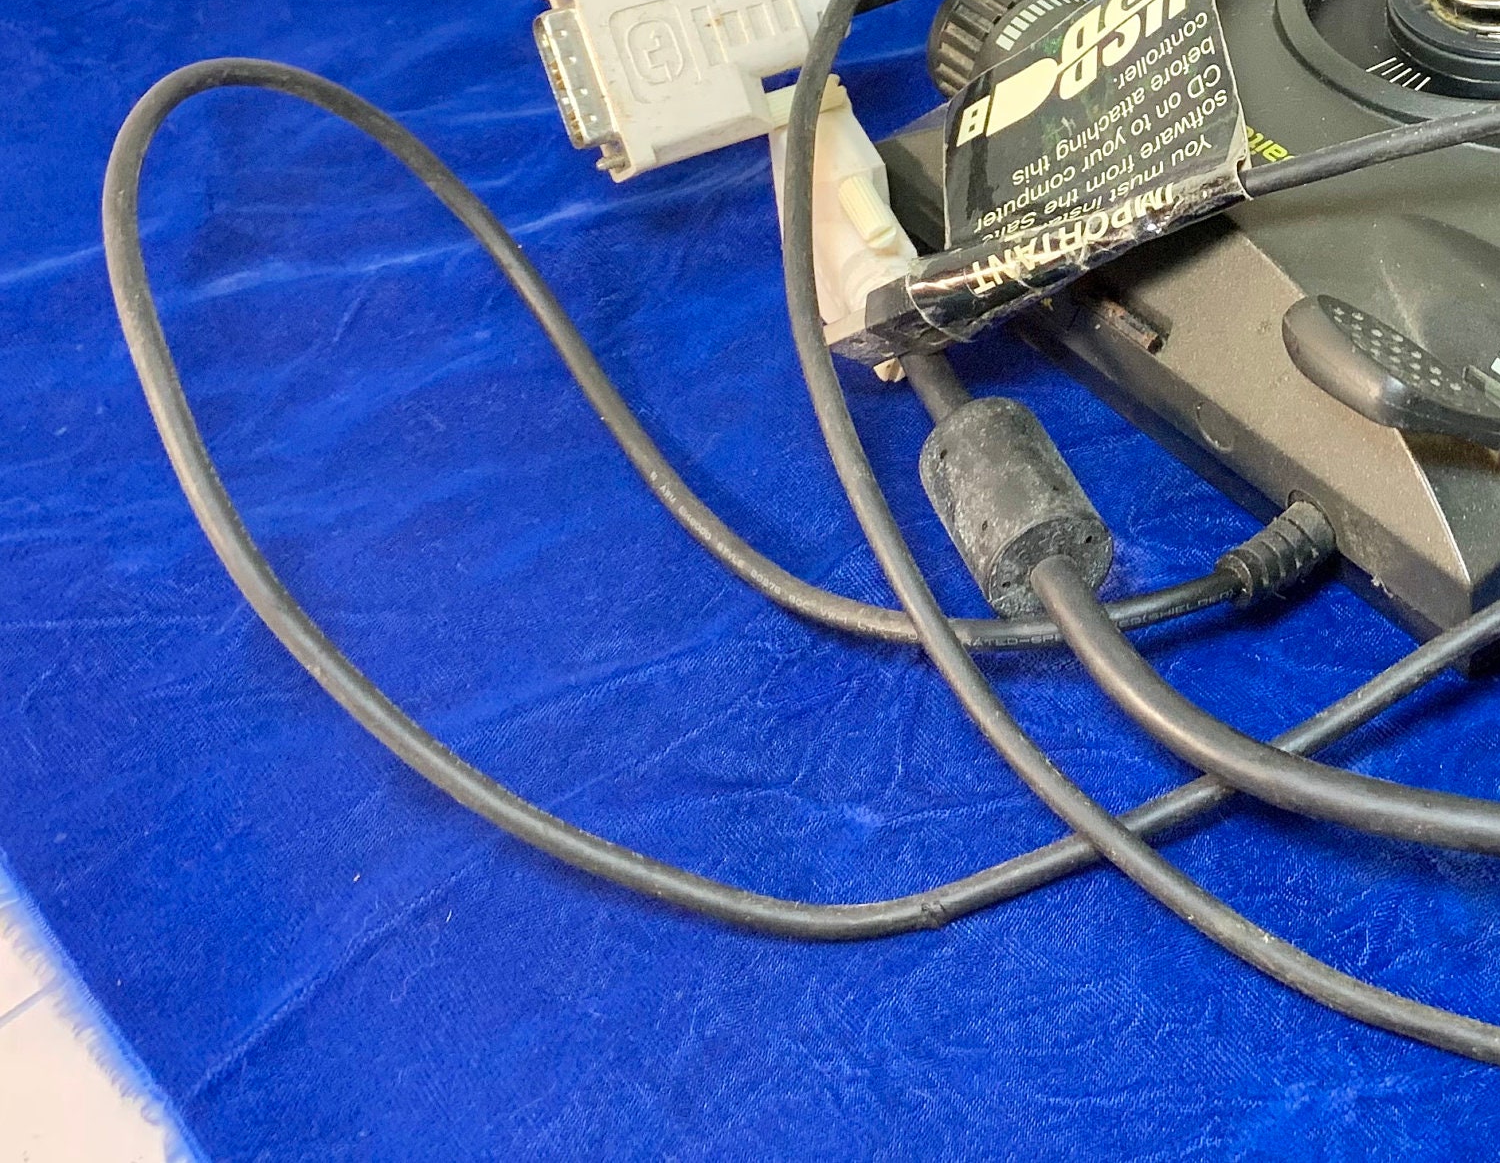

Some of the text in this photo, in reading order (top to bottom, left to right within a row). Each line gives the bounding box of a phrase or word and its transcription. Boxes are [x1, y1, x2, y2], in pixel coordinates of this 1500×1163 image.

[1113, 12, 1208, 90] controller.
[1011, 36, 1216, 186] before attaching this
[1140, 89, 1228, 159] software
[973, 64, 1221, 234] CD on to your computer
[1086, 154, 1135, 193] from
[1109, 160, 1164, 203] must
[1171, 134, 1212, 166] You
[1044, 188, 1079, 215] the
[973, 181, 1175, 295] IMPORTANT
